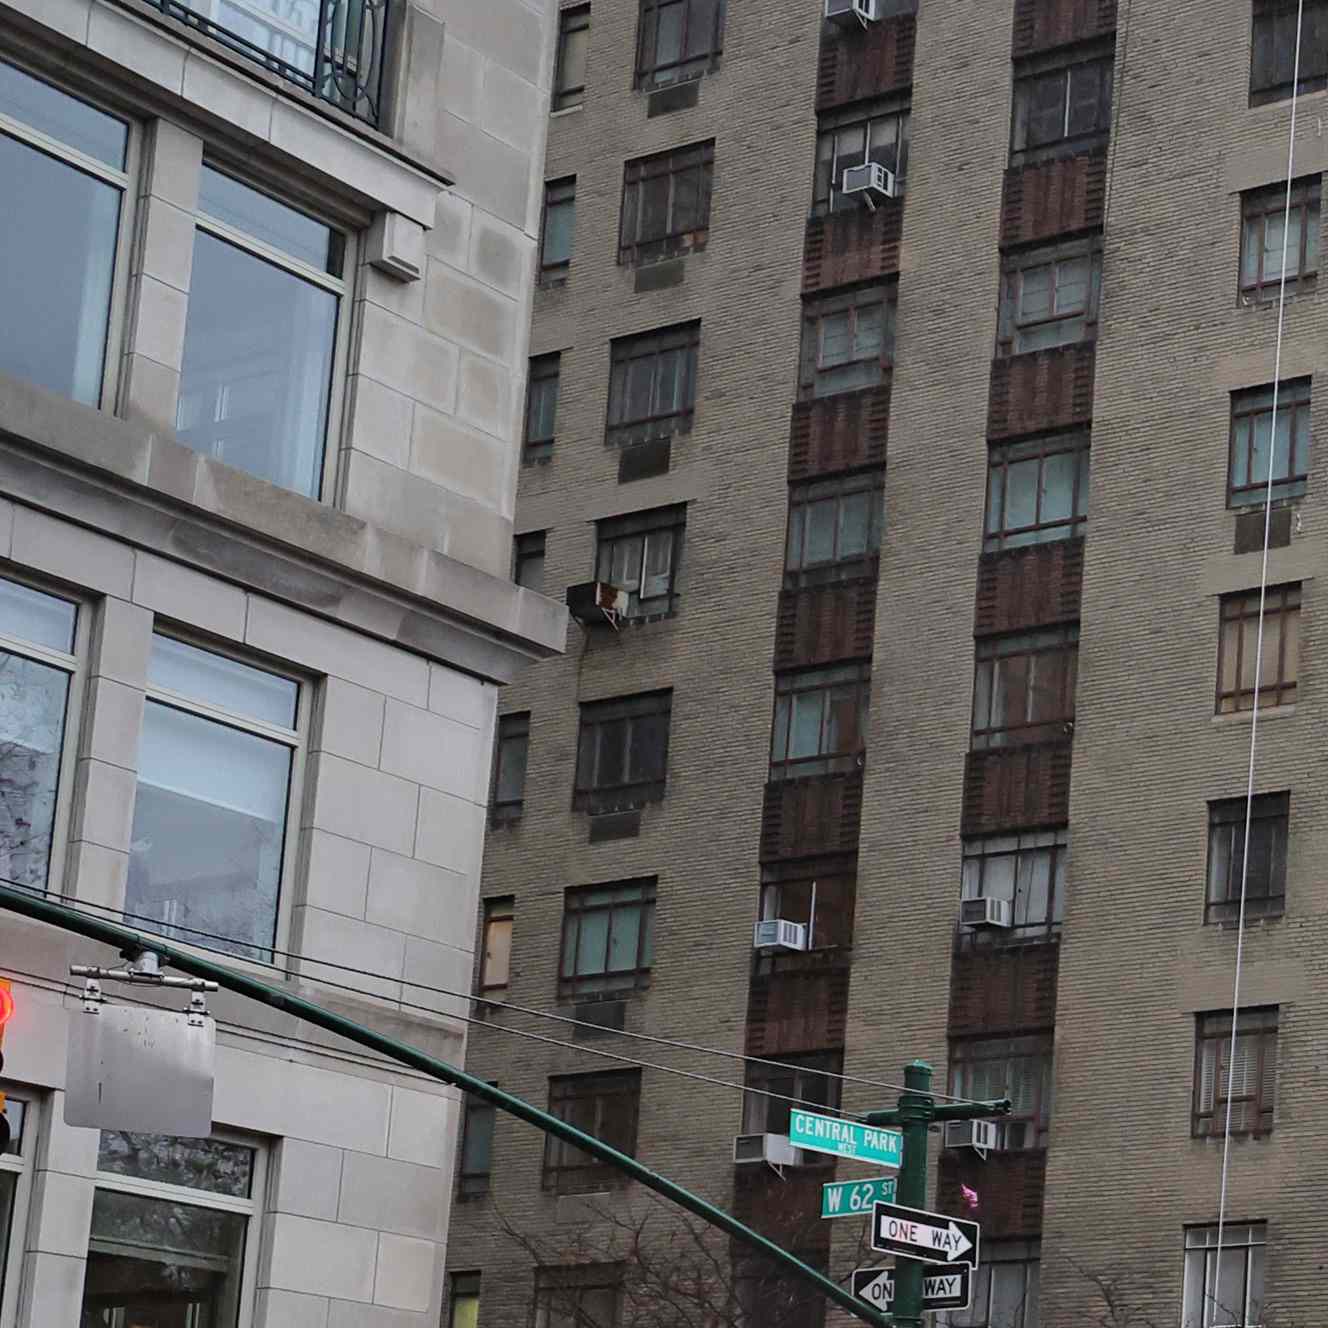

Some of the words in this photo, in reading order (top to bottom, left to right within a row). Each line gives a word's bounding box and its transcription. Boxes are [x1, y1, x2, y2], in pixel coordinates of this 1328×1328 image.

[795, 1115, 857, 1144] CENTRAL
[863, 1130, 897, 1153] PARK
[827, 1187, 842, 1213] W
[849, 1184, 874, 1211] 62
[881, 1181, 893, 1196] ST
[888, 1220, 918, 1242] ONE
[931, 1229, 962, 1251] WAY
[871, 1282, 893, 1300] ON
[923, 1277, 957, 1297] WAY
